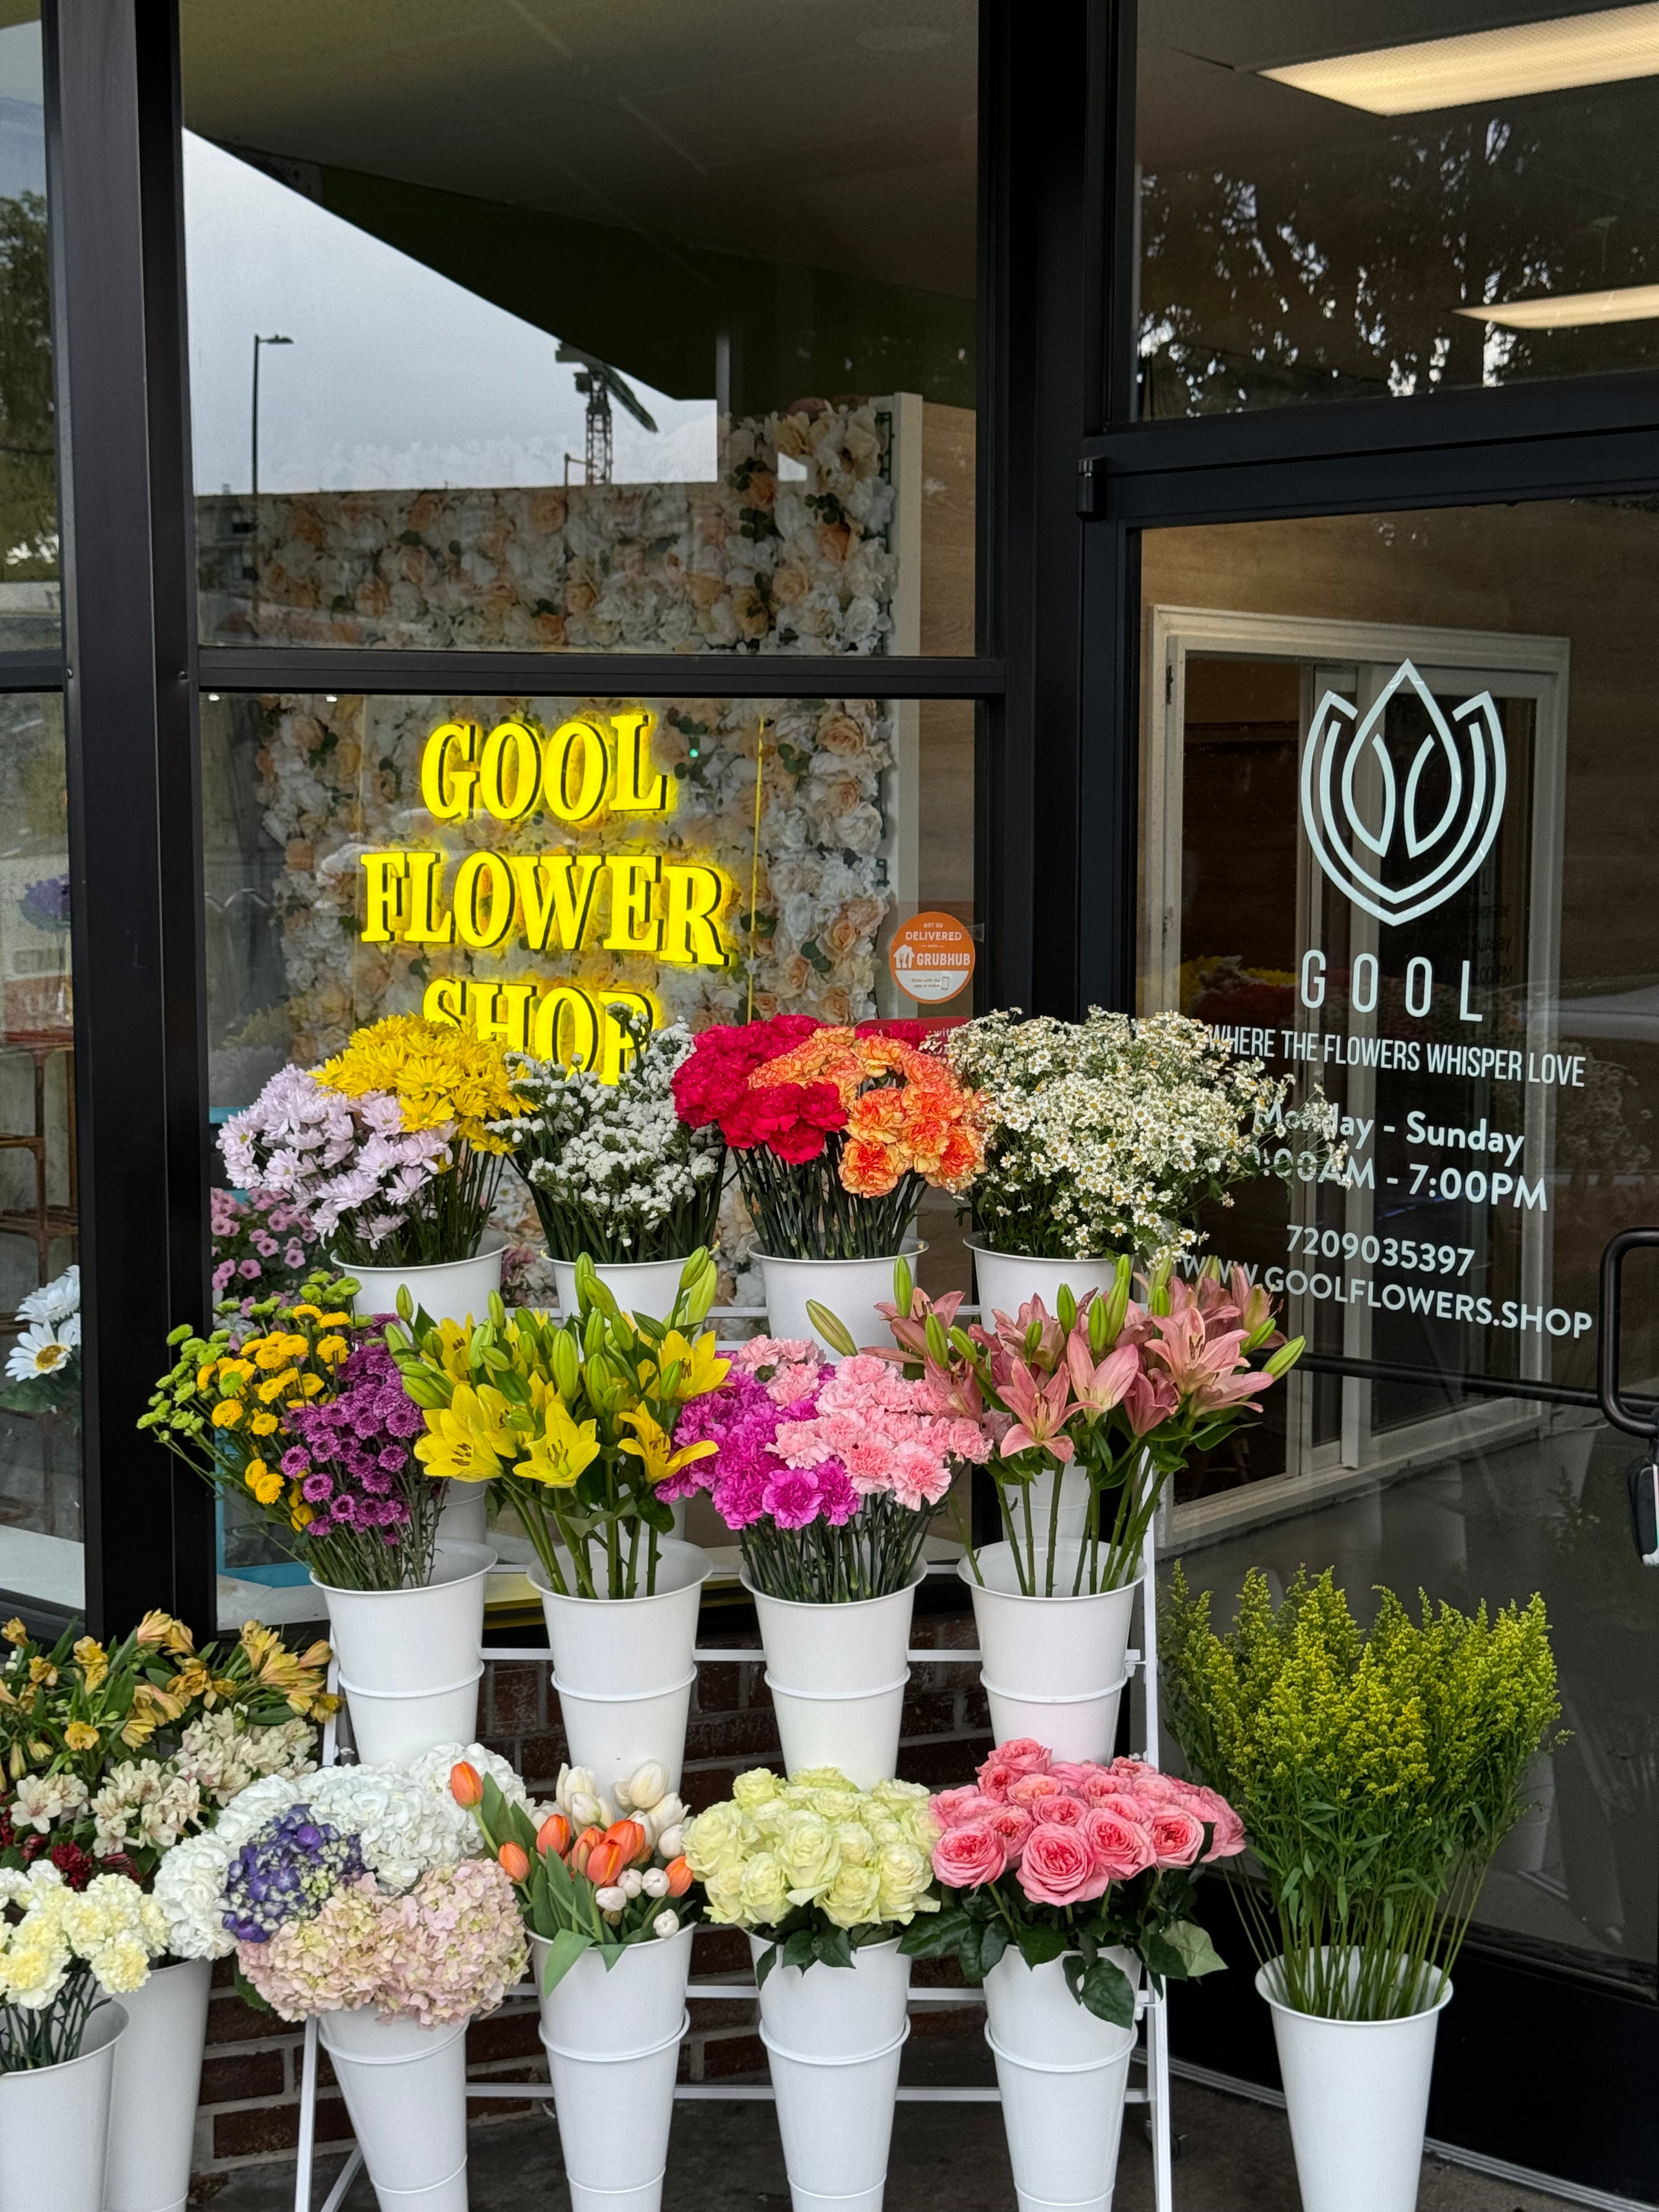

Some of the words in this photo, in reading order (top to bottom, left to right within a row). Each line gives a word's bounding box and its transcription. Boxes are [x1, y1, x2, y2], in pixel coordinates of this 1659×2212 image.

[421, 715, 668, 821] GOOL
[360, 851, 732, 967] FLOWER
[906, 932, 962, 941] DELIVERED
[917, 953, 970, 966] GRUBHUB
[1301, 949, 1483, 1022] GOOL
[1209, 1024, 1276, 1057] WHERE
[1281, 1030, 1319, 1062] THE
[1324, 1034, 1420, 1072] FLOWERS
[1426, 1043, 1522, 1082] WHISPER
[1528, 1052, 1586, 1087] LOVE
[1406, 1110, 1525, 1167] Sunday
[1409, 1164, 1548, 1211] 7:00PM
[1286, 1224, 1476, 1277] 7209035397
[1183, 1254, 1592, 1339] WWWGOOLFLOWERS.SHOP
